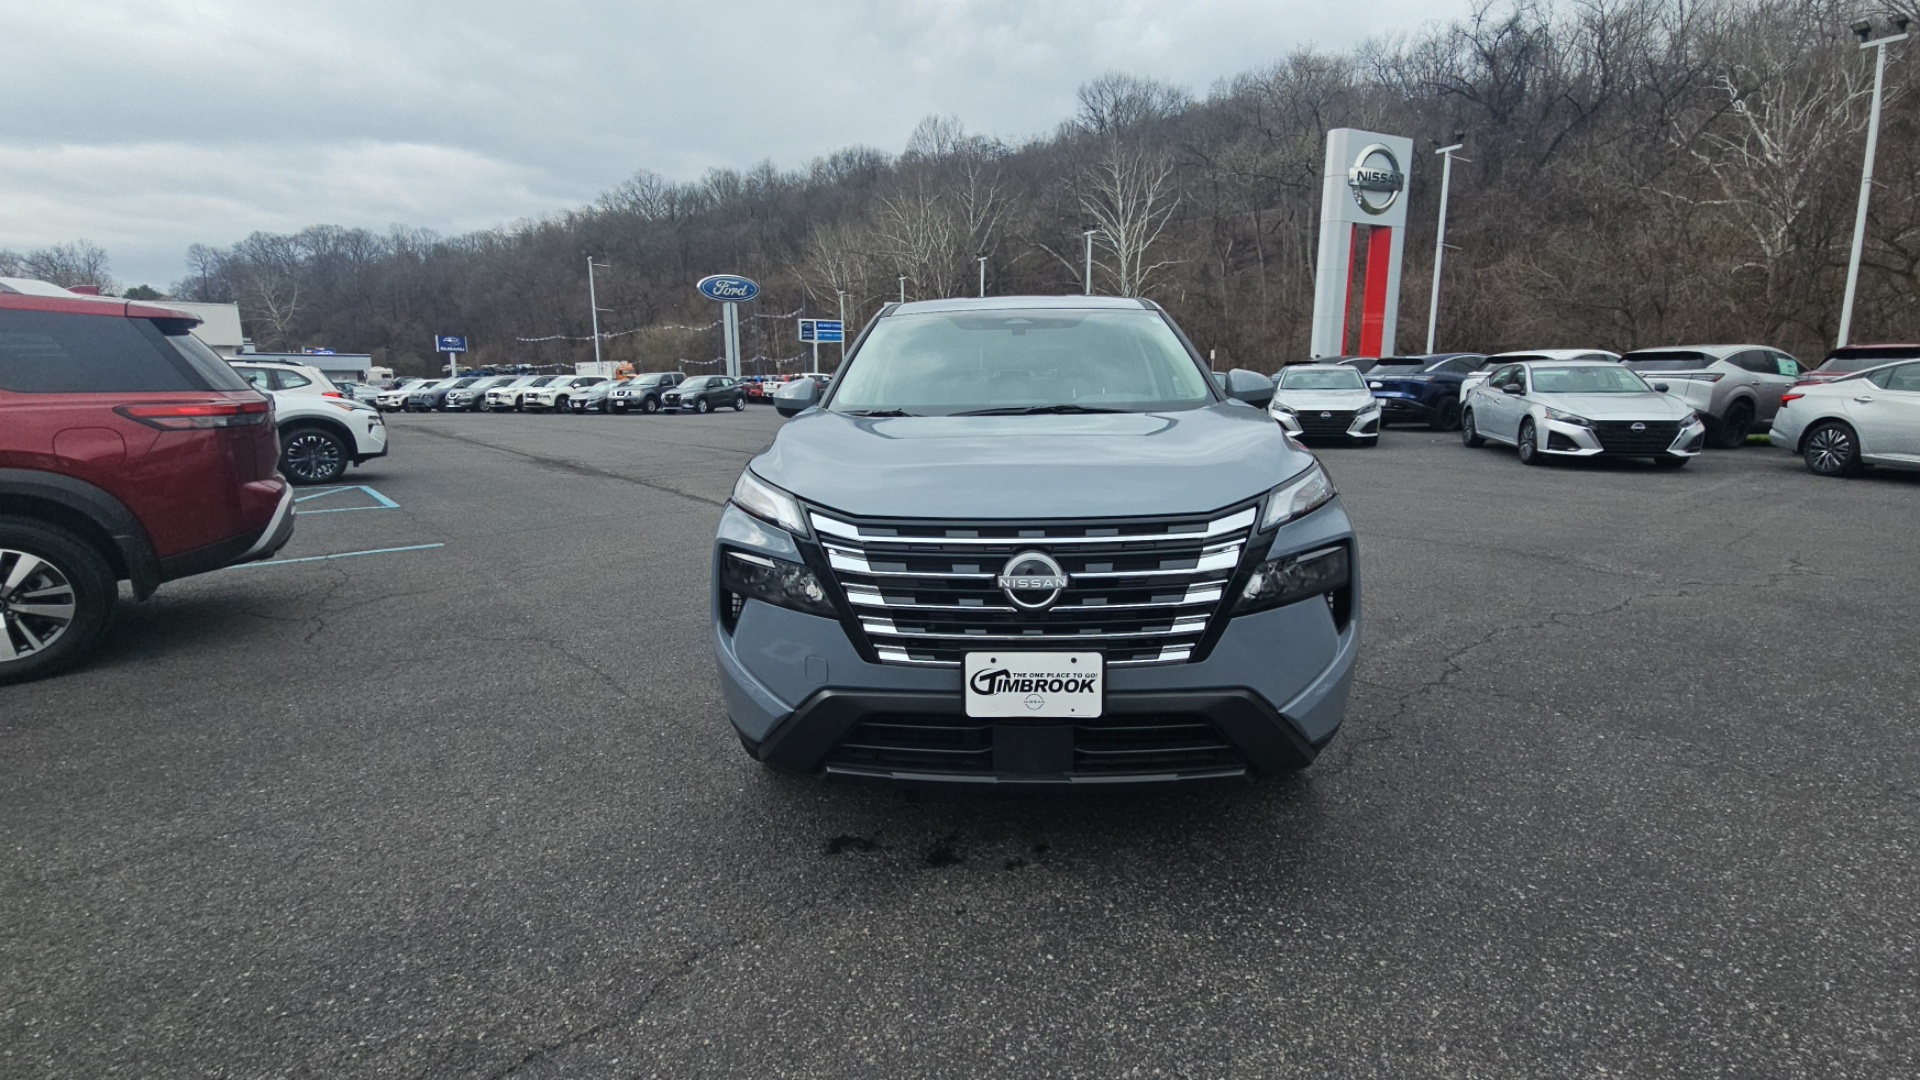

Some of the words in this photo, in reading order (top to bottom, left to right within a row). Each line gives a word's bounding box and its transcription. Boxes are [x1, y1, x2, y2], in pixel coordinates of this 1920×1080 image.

[712, 279, 748, 296] Ford
[999, 578, 1067, 589] NISSAN
[970, 668, 1096, 695] TIMBROOK
